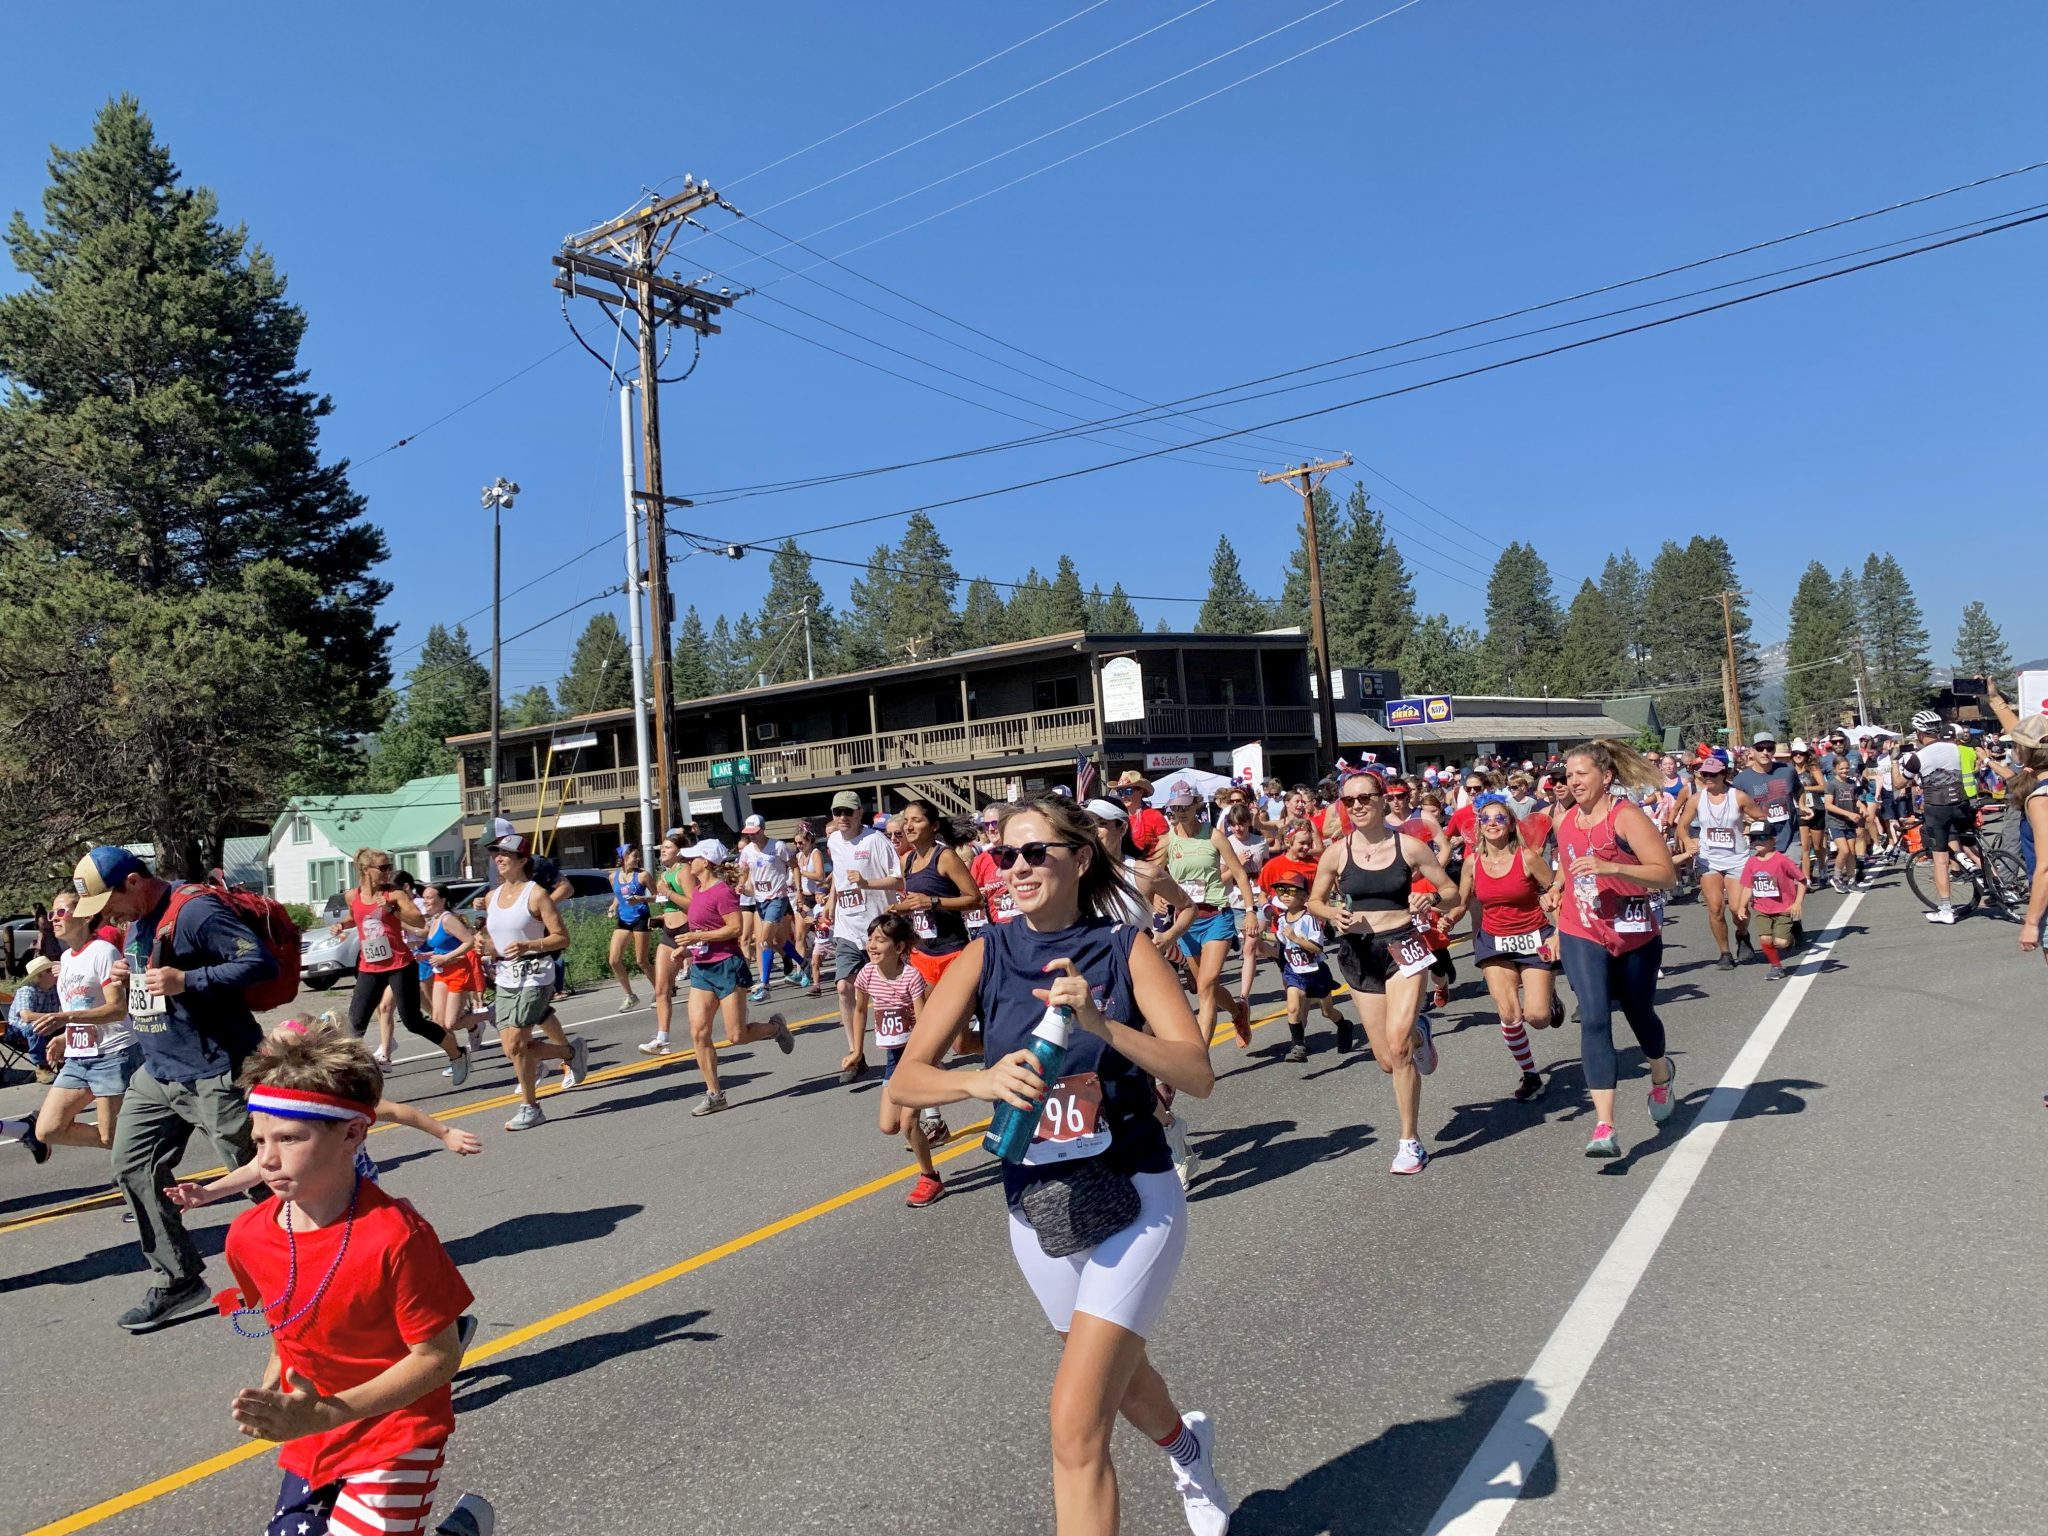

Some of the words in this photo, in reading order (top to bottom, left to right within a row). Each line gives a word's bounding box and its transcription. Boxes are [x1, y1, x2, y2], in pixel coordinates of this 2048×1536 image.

[1391, 710, 1419, 719] SIERRA
[1431, 705, 1444, 714] NAPA
[714, 763, 732, 777] LAKE
[738, 763, 748, 772] VE
[1768, 806, 1784, 817] 908
[1710, 832, 1731, 842] 1055
[1753, 880, 1775, 891] 1054
[840, 893, 860, 909] 1021
[1501, 934, 1536, 952] 5386
[364, 944, 387, 959] 5340
[1400, 940, 1425, 964] 865
[150, 1022, 168, 1033] 2014
[881, 1016, 904, 1035] 695
[71, 1032, 89, 1048] 708
[1045, 1094, 1085, 1136] 96
